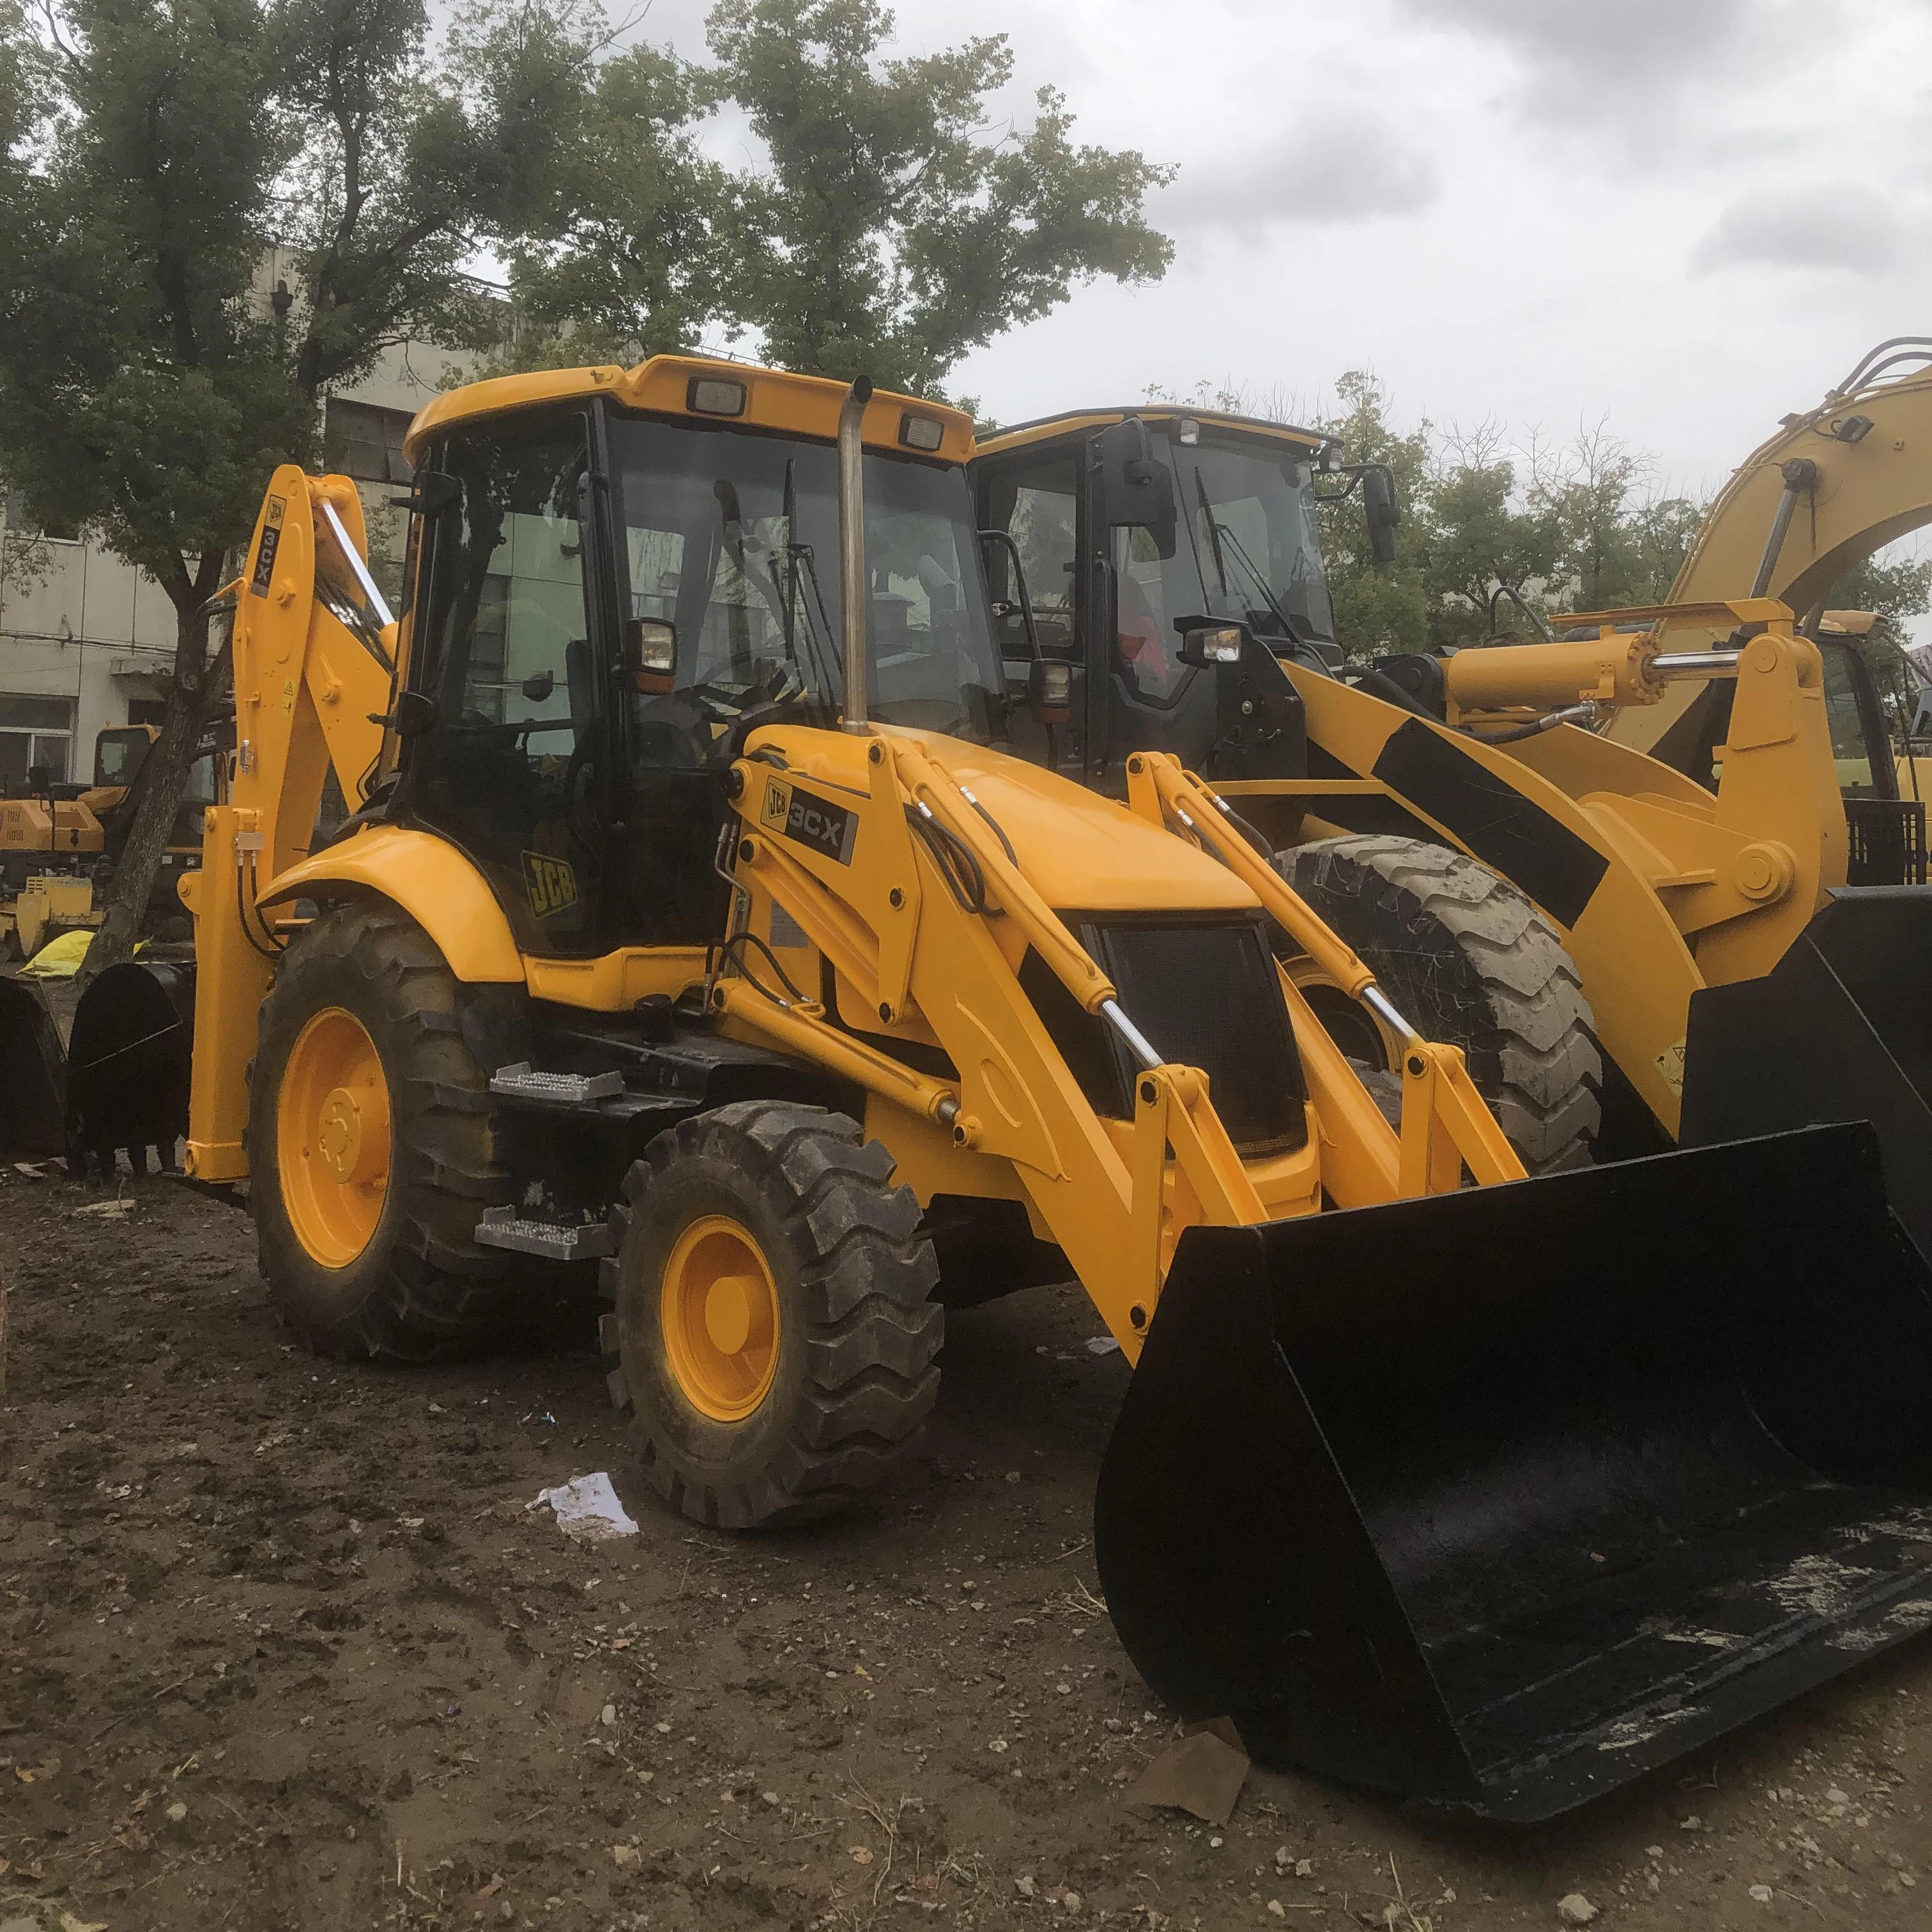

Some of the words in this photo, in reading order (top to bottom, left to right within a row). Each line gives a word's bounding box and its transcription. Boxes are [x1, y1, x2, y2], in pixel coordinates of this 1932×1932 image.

[257, 531, 275, 581] 3CX
[770, 788, 786, 815] JCB
[789, 802, 841, 847] 3CX
[530, 858, 574, 912] JCB
